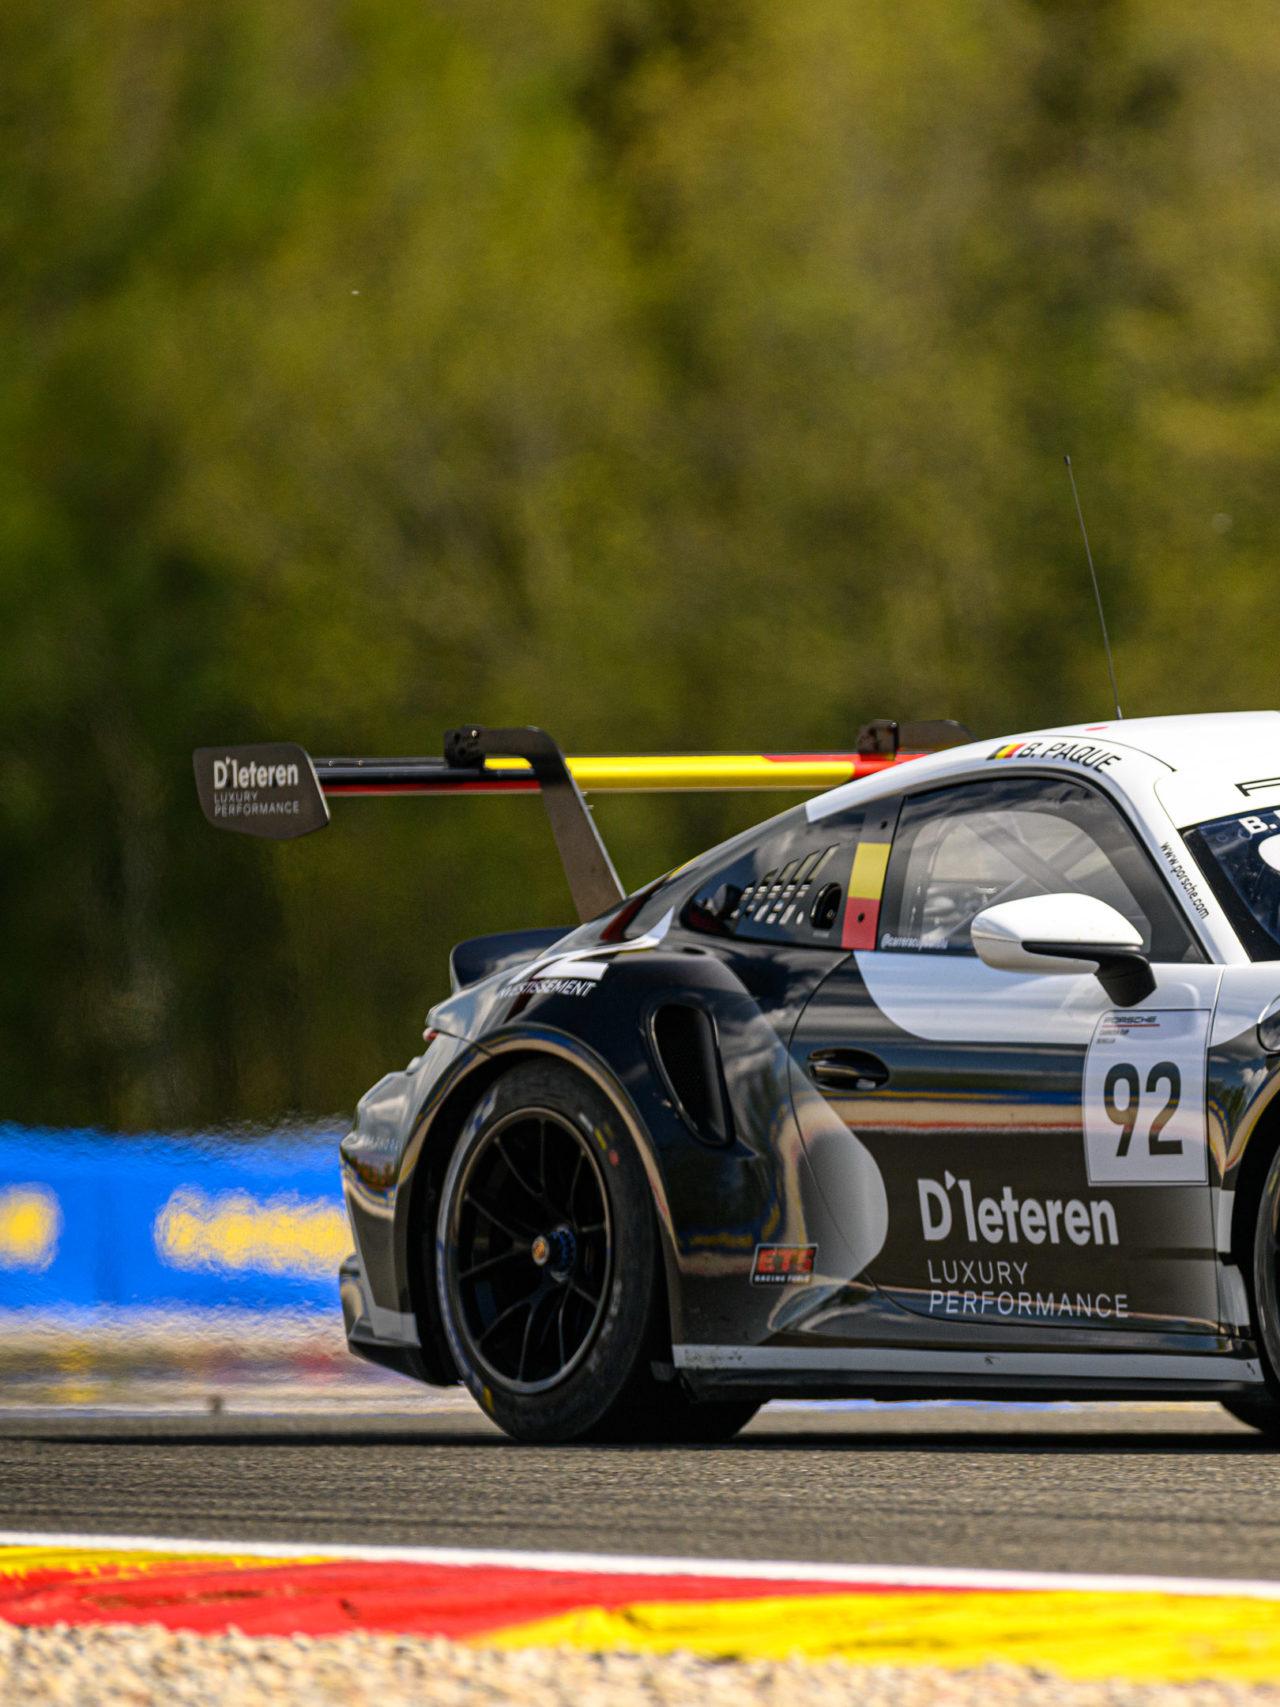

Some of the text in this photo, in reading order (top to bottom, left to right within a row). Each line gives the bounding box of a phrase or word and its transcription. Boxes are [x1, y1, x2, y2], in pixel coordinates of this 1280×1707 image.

[1017, 742, 1122, 773] B. PAQUE
[213, 790, 259, 805] LUXURY
[214, 800, 300, 817] PERFORMANCE
[1238, 814, 1278, 837] B.
[1160, 841, 1210, 920] www.porsche.com
[1103, 1061, 1184, 1157] 92
[757, 1247, 815, 1273] ETS
[927, 1259, 1028, 1285] LUXURY
[929, 1290, 1130, 1319] PERFORMANCE
